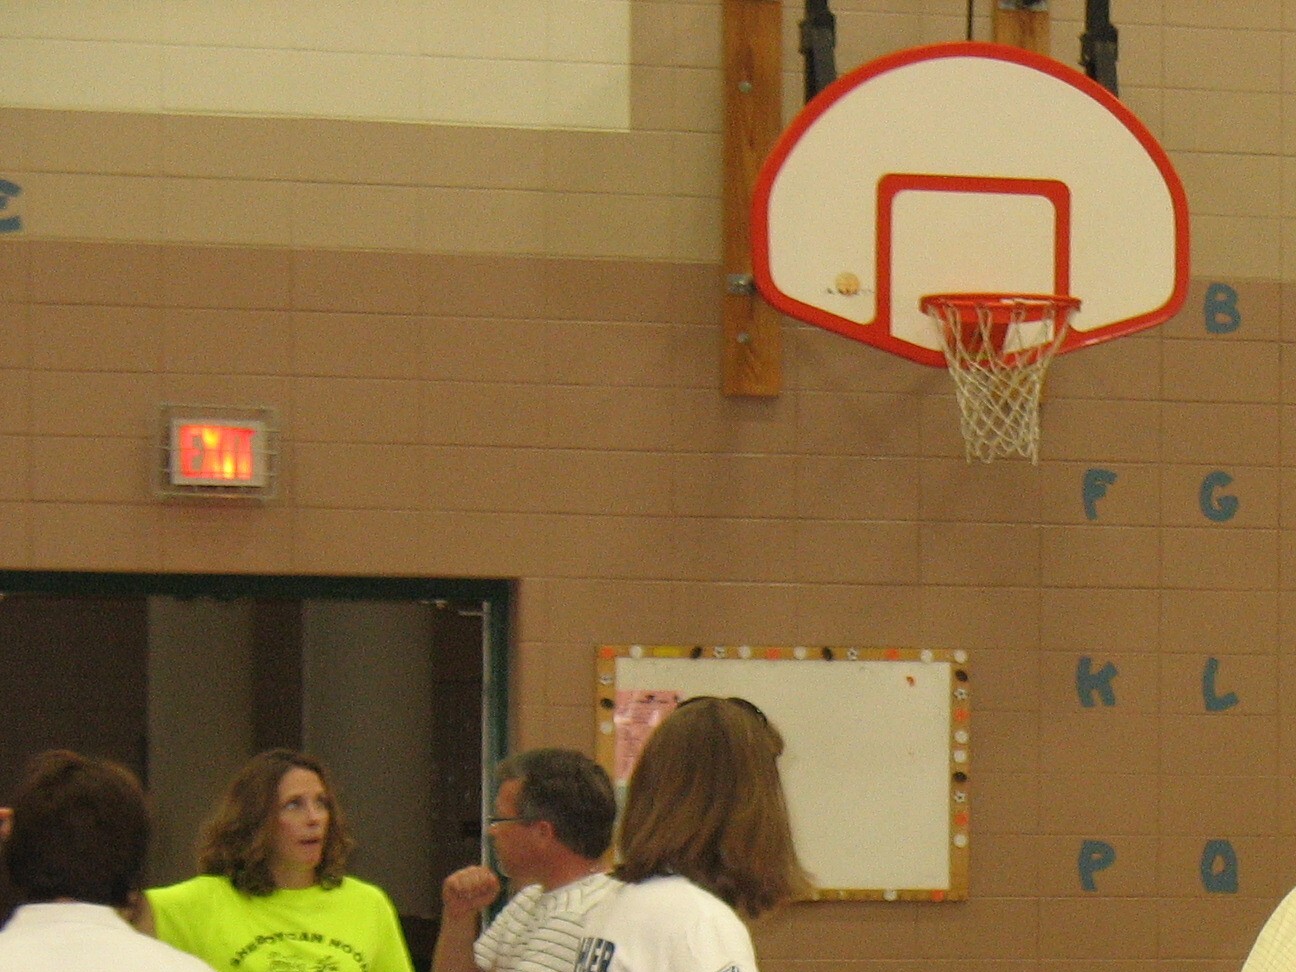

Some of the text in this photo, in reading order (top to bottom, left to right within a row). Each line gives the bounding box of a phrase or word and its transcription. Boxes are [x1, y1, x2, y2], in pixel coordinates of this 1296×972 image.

[1204, 284, 1241, 333] B
[179, 425, 256, 480] EXIT
[1082, 469, 1117, 520] F
[1200, 471, 1238, 522] G
[1076, 658, 1117, 706] K
[1203, 658, 1238, 710] L
[1078, 839, 1238, 893] P Q
